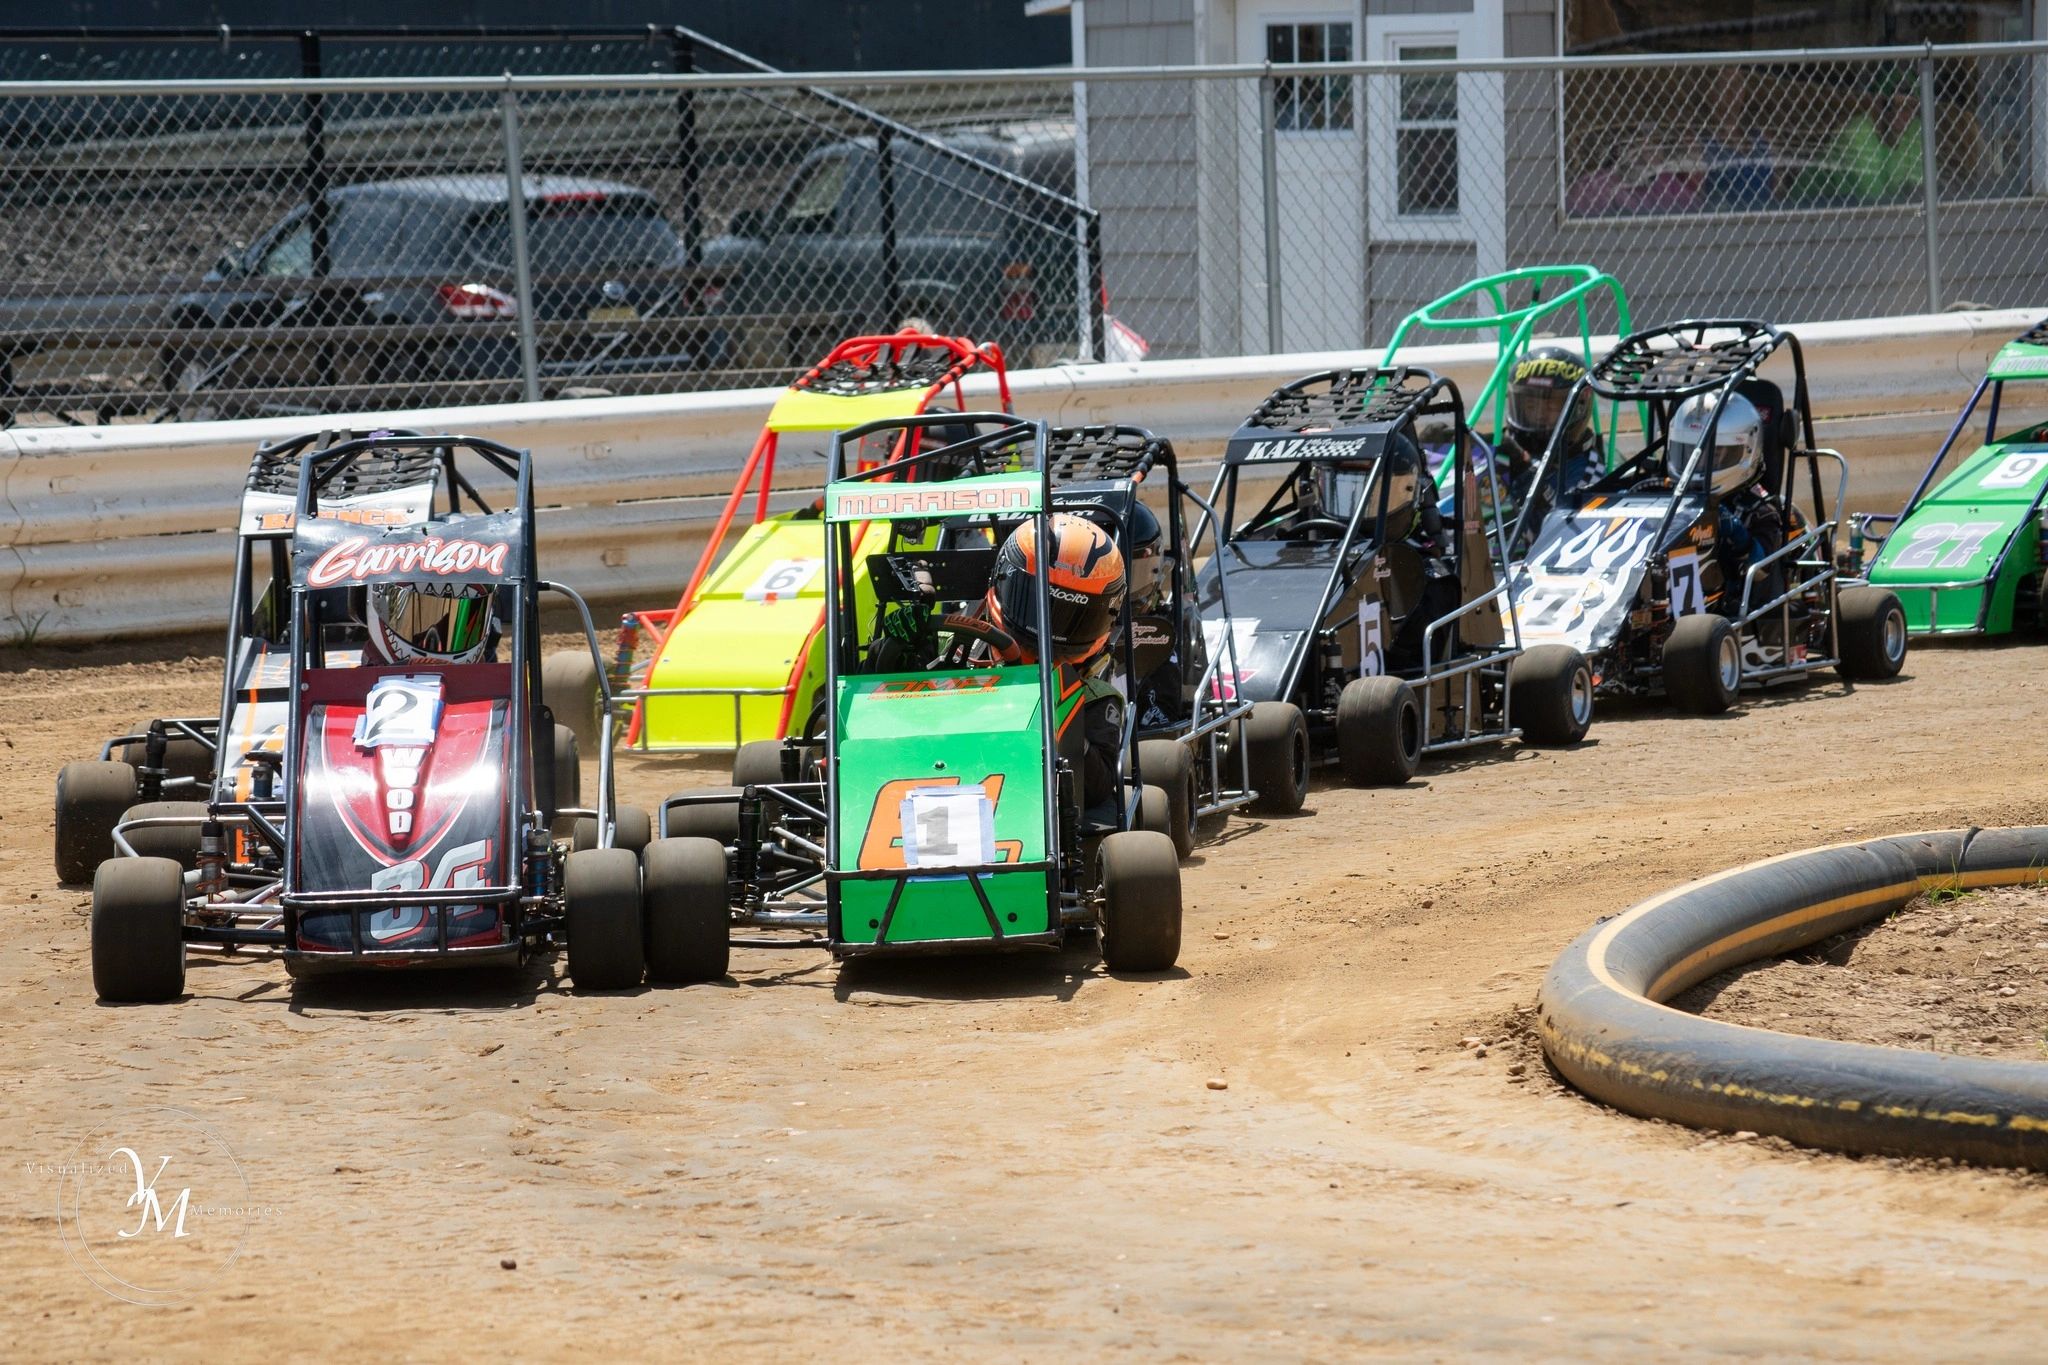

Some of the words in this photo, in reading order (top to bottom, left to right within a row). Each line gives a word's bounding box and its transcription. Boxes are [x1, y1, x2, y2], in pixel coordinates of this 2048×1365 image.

[1514, 358, 1586, 385] BUTTERCU
[1245, 439, 1305, 460] KAZ
[2000, 457, 2038, 480] 9
[838, 487, 1030, 515] MORRISON
[307, 535, 509, 588] Garrison
[763, 566, 804, 590] 6
[1672, 563, 1697, 616] 7
[367, 689, 418, 741] 2
[916, 806, 959, 856] 1
